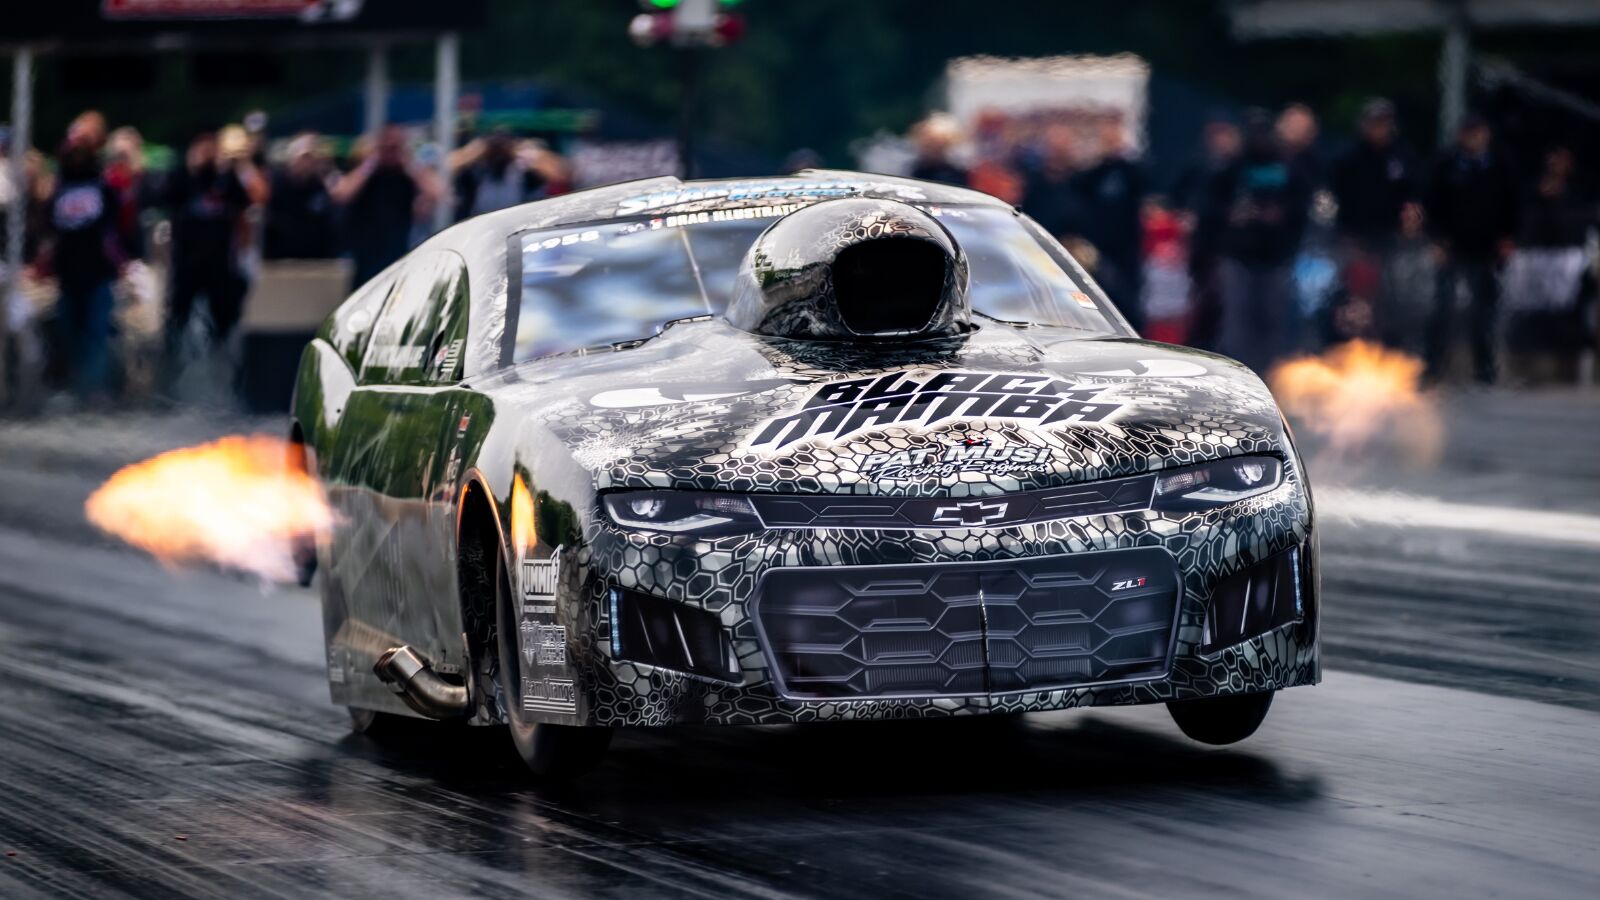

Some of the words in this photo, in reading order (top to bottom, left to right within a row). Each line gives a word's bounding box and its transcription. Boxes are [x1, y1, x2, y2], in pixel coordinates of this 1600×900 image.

[666, 212, 709, 227] DRAG
[802, 371, 1109, 411] BLACK
[750, 392, 1124, 451] MAMBA
[861, 448, 937, 472] PAT
[947, 446, 1052, 464] MUSI
[870, 461, 957, 482] Racing
[960, 459, 1048, 477] Engines
[1111, 577, 1146, 591] ZL1
